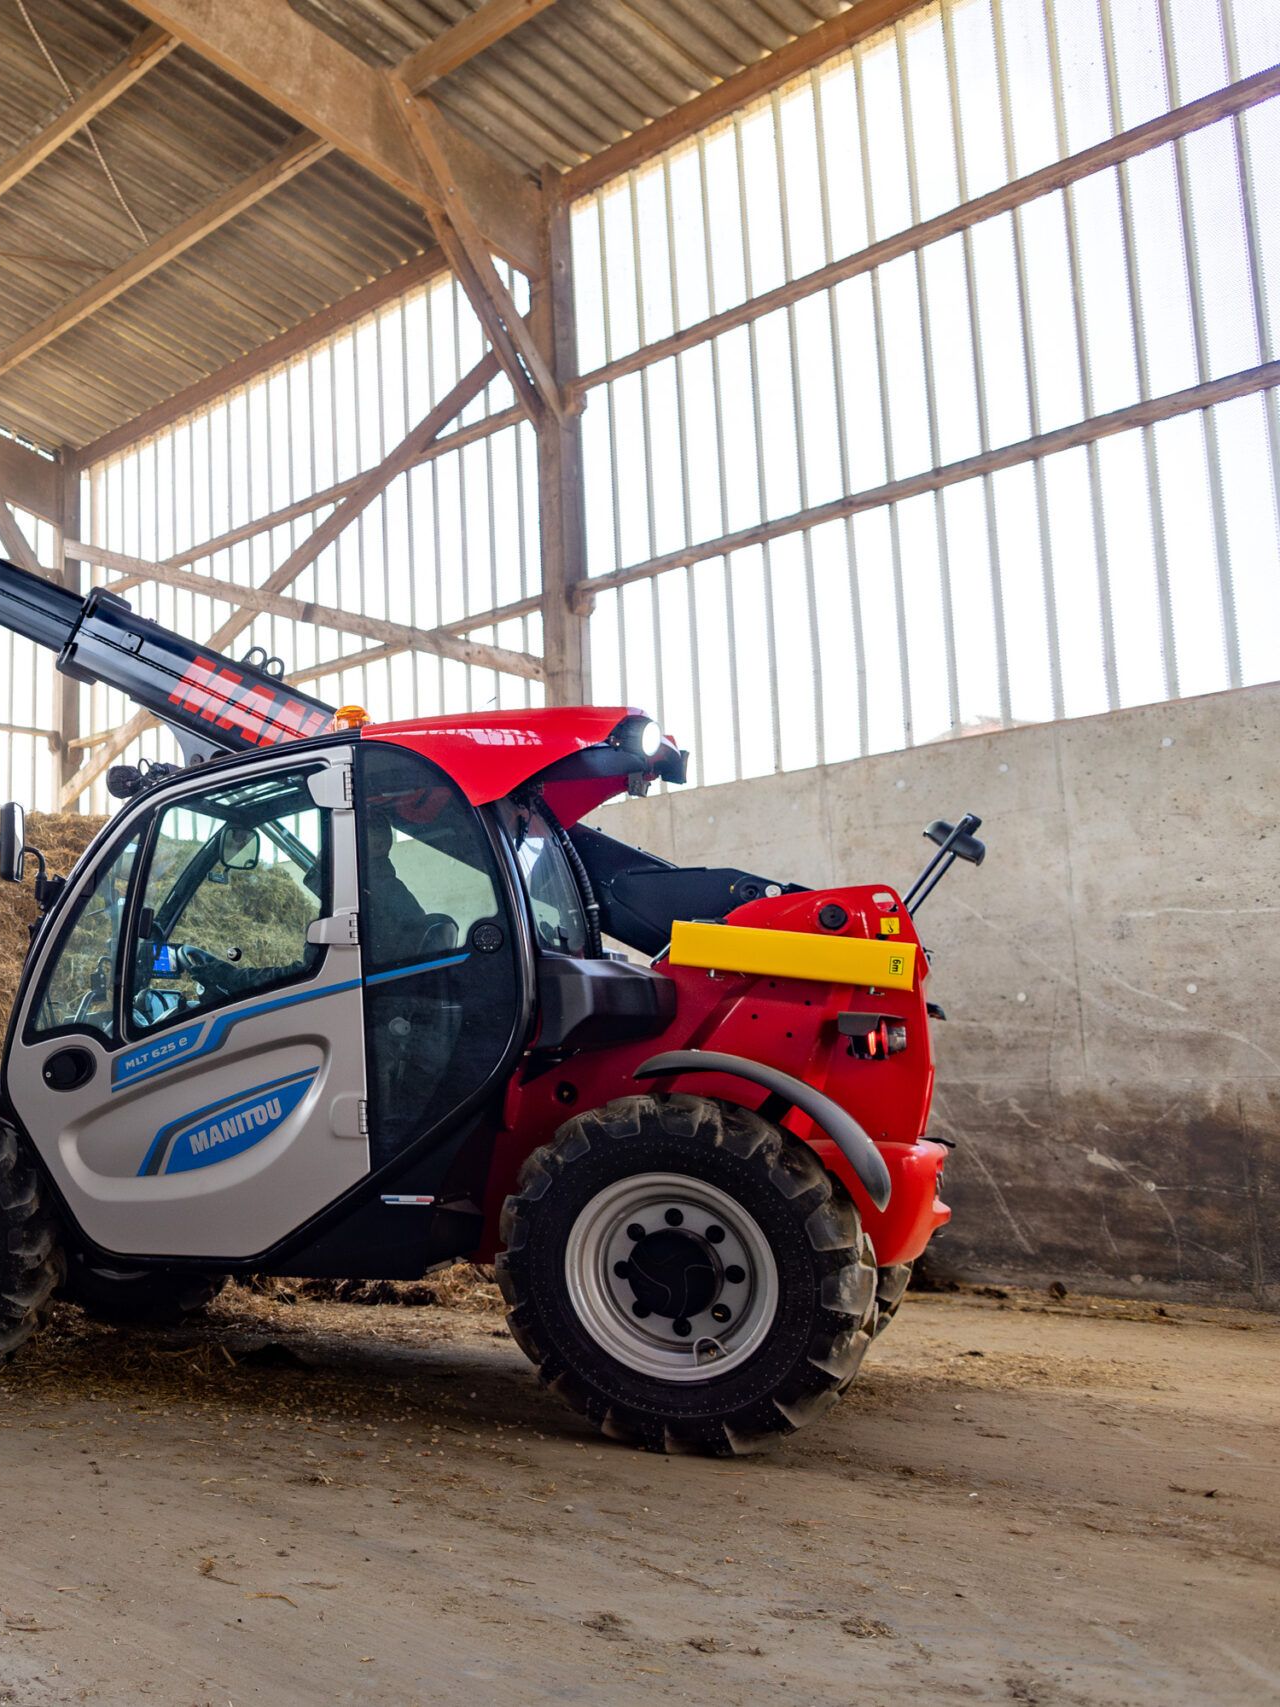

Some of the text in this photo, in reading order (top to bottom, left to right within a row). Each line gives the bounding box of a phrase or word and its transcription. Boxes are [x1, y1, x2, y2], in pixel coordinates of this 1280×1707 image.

[168, 656, 333, 747] MAN
[892, 959, 901, 973] 6m
[125, 1037, 188, 1070] MLT 625 e
[189, 1097, 282, 1155] MANITOU
